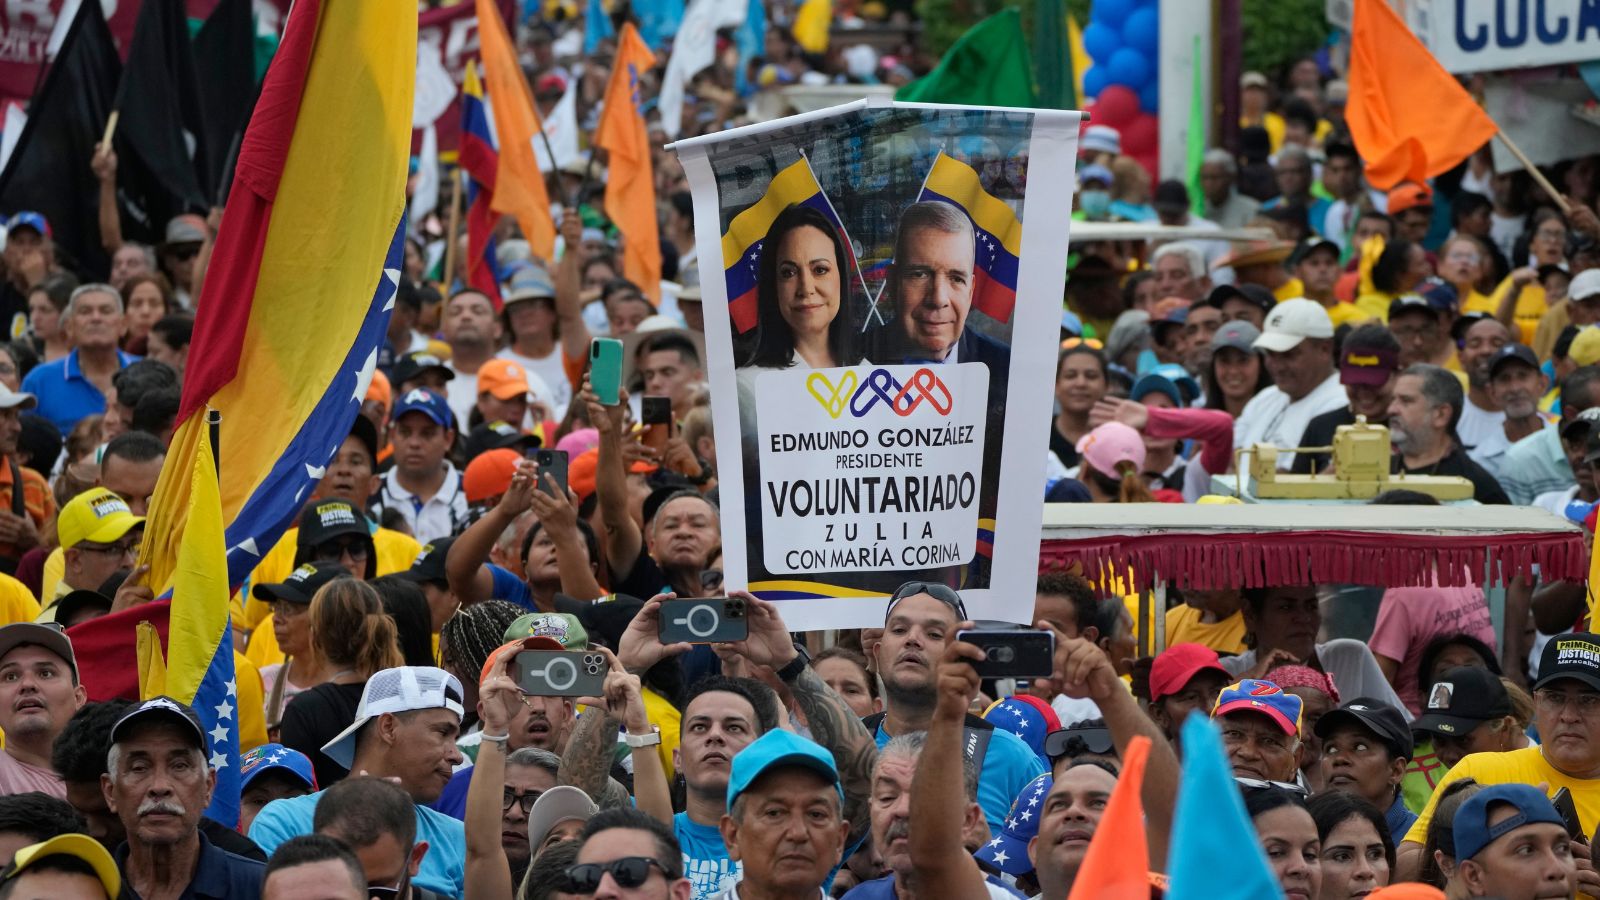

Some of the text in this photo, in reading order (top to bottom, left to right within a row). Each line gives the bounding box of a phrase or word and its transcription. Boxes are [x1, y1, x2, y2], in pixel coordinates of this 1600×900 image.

[770, 421, 974, 453] EDMUNDO GONZÁLEZ
[836, 452, 923, 470] PRESIDENTE
[767, 471, 976, 518] VOLUNTARIADO
[785, 542, 960, 570] CON MARÍA CORINA
[1557, 649, 1600, 663] JUSTICIA
[1559, 641, 1600, 653] PRIMERO
[1557, 660, 1599, 669] Maracaibo
